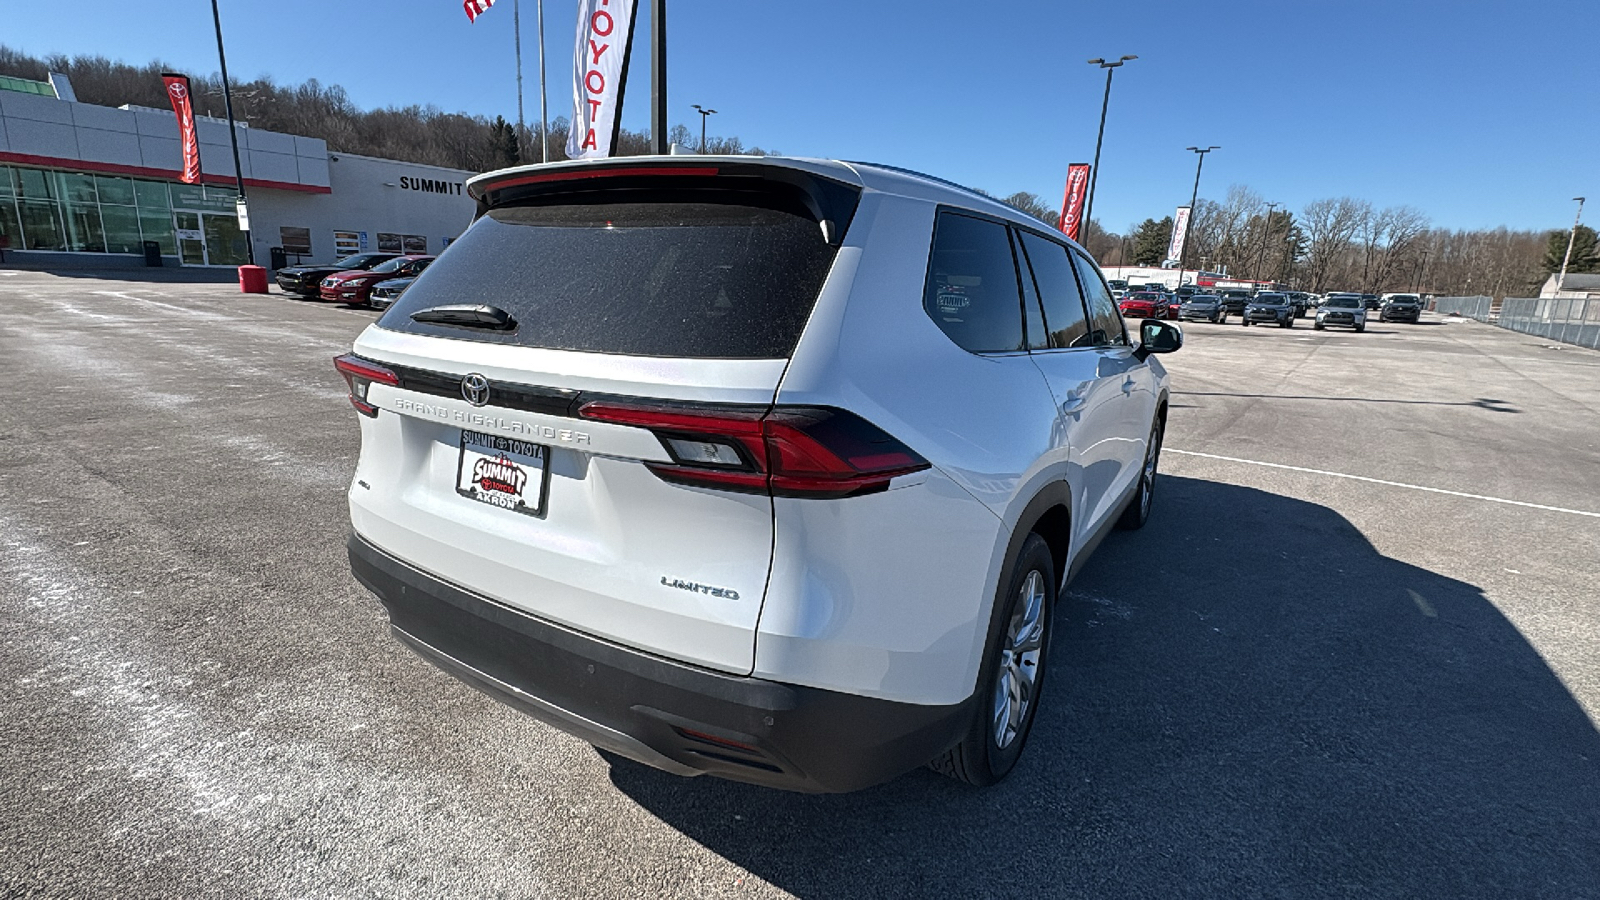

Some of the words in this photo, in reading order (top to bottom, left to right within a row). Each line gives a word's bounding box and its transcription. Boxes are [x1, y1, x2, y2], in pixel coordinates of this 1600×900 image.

[582, 0, 614, 151] OYOTA
[400, 176, 463, 196] SUMMIT
[1064, 183, 1079, 235] TOYOT
[395, 398, 449, 418] GRAND
[454, 410, 591, 445] HIGHLANDER
[462, 430, 496, 448] SUMMIT
[508, 440, 544, 459] TOYOTA
[474, 458, 526, 493] SUMMIT
[492, 481, 515, 494] TOYOTA
[476, 491, 515, 510] AKRON
[660, 576, 740, 601] LIMITED
